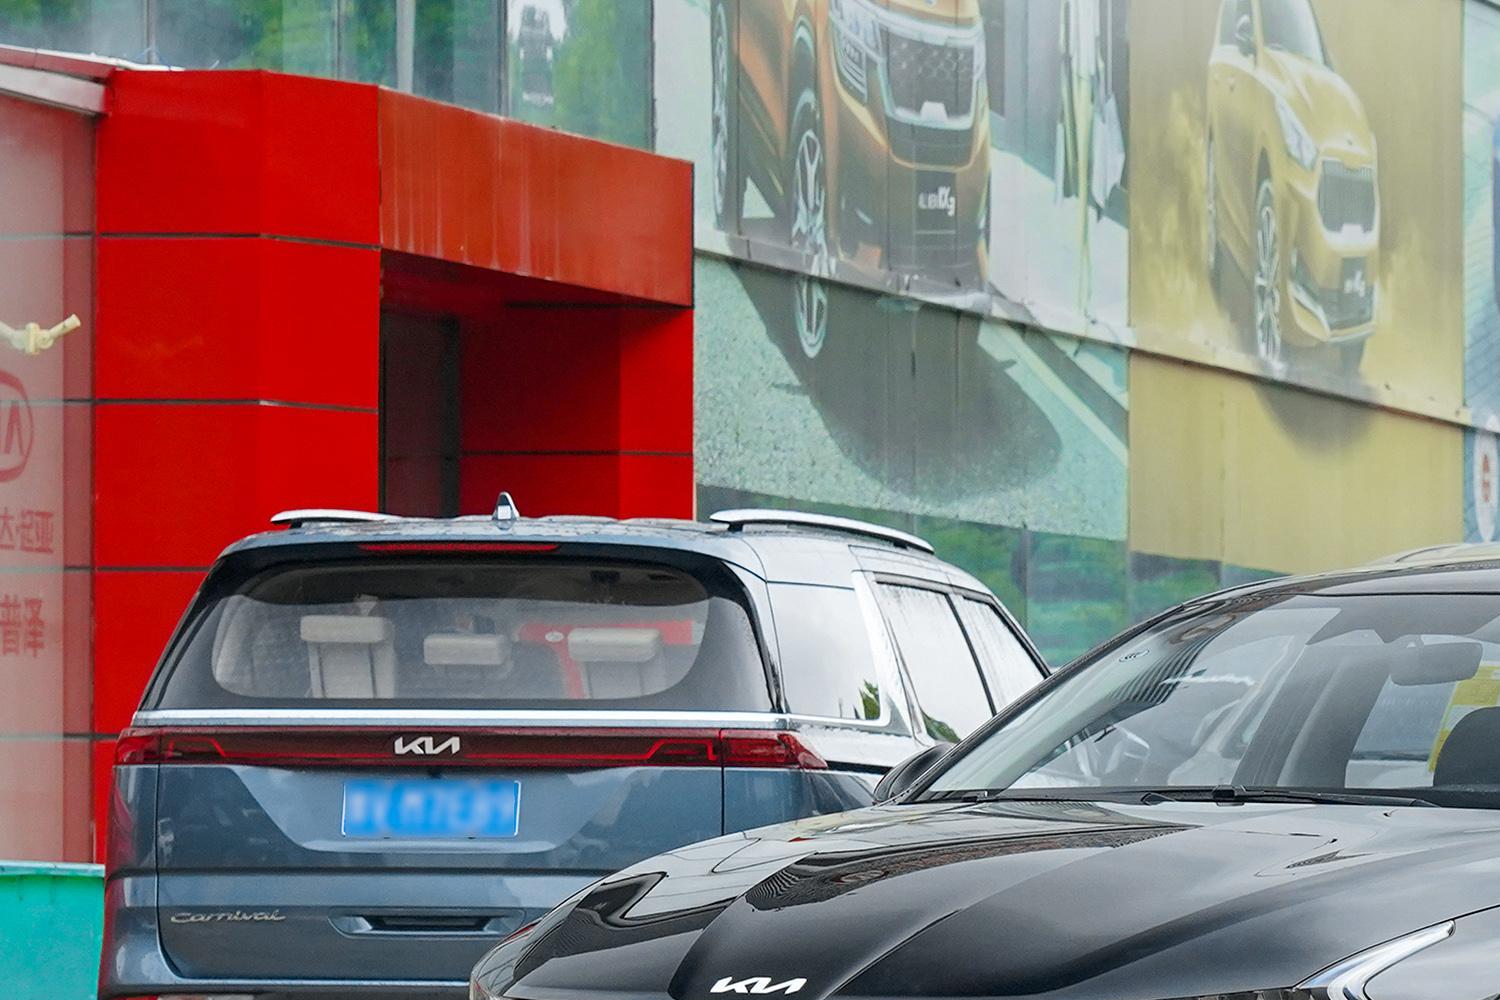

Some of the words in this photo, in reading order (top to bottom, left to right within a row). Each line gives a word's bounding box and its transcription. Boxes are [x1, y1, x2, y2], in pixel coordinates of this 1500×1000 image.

[394, 736, 460, 754] KIA
[170, 909, 286, 923] Carnival
[710, 976, 807, 995] KIA
